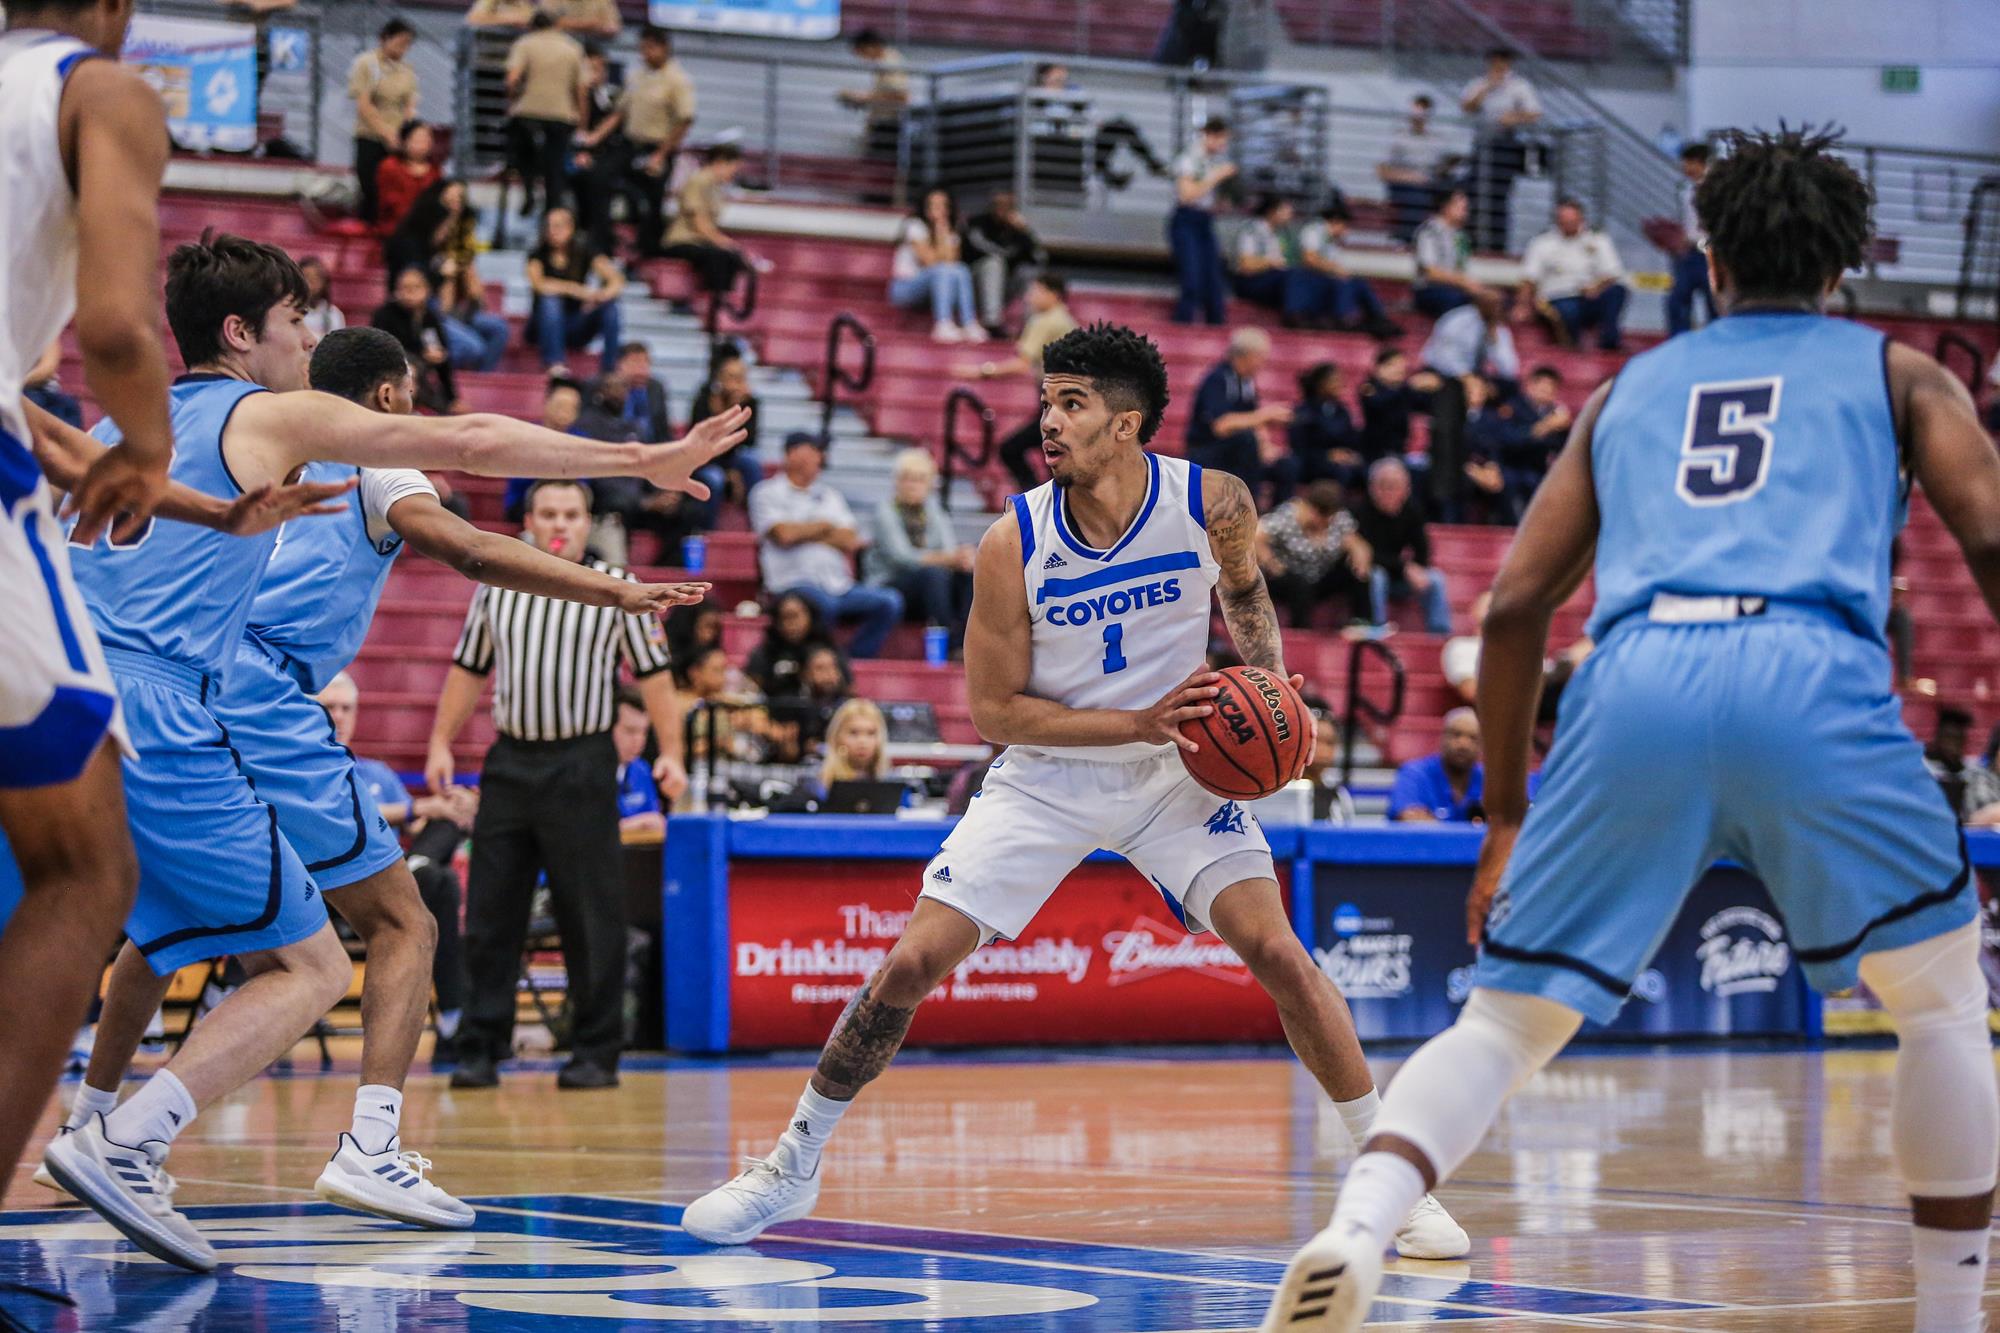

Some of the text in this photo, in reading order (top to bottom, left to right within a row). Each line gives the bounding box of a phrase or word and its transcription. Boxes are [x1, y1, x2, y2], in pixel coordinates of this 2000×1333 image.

[1674, 375, 1784, 508] 5
[1043, 559, 1068, 570] adidas
[1046, 578, 1182, 627] COYOTES
[1102, 622, 1127, 675] 1
[1210, 686, 1257, 745] NCAA
[1240, 668, 1291, 744] Wilson
